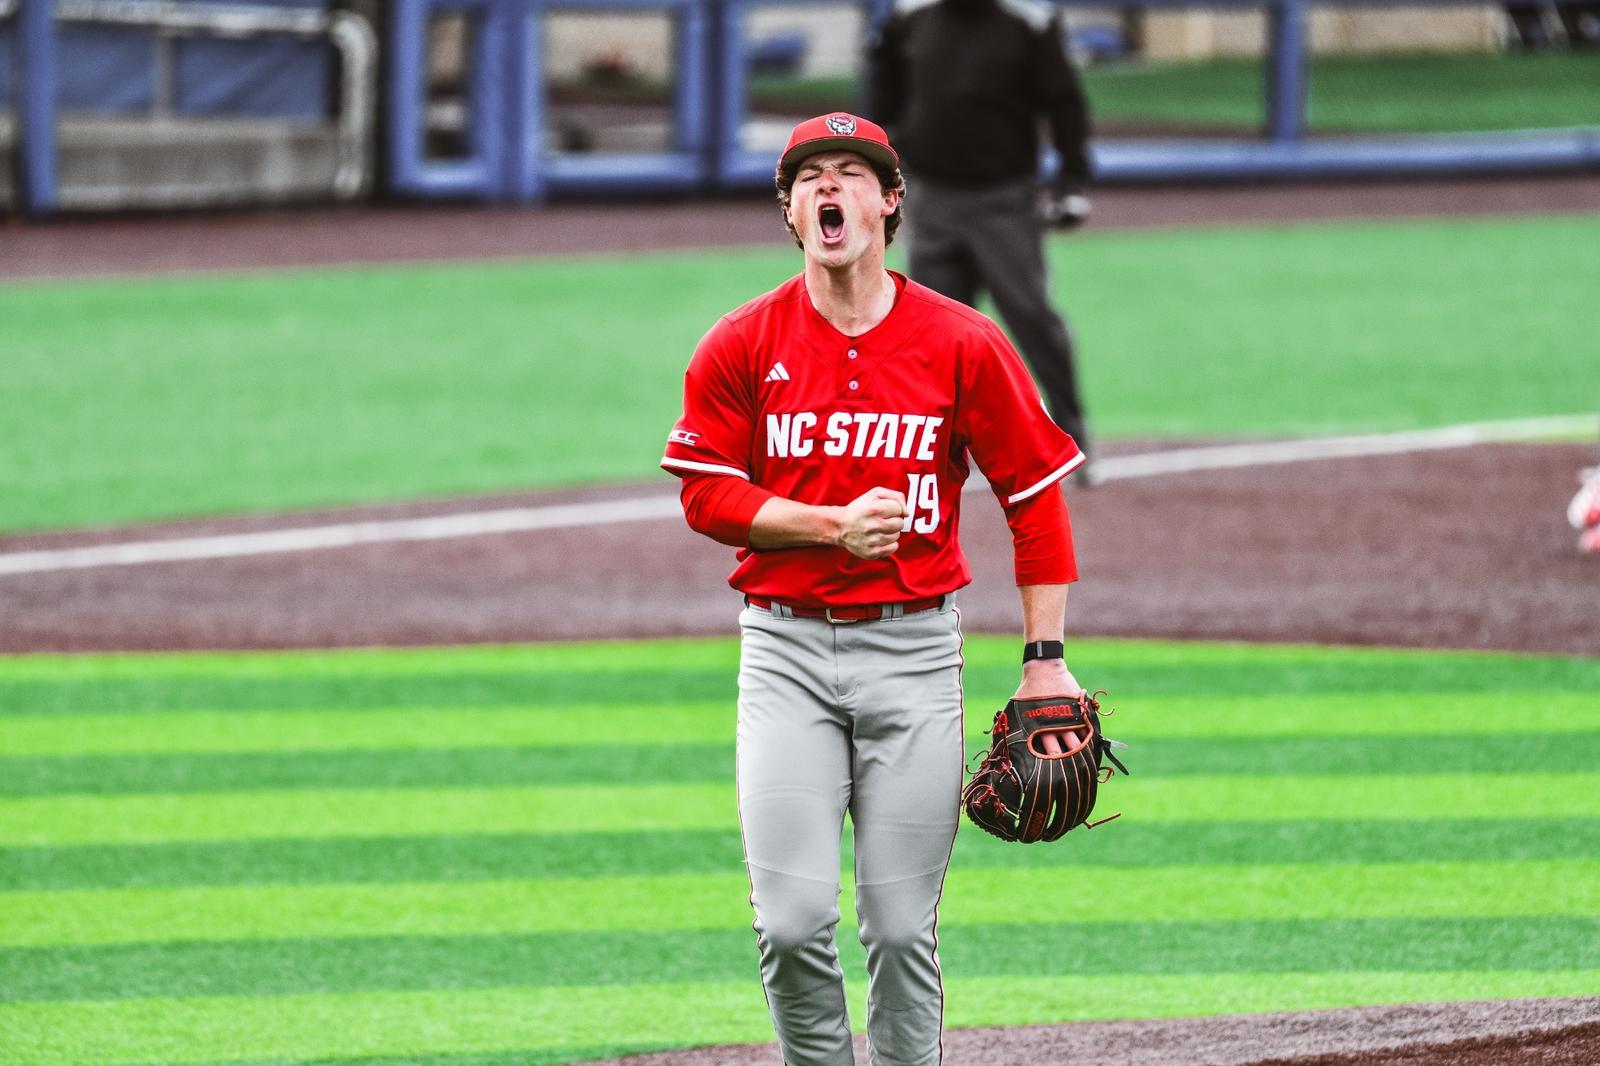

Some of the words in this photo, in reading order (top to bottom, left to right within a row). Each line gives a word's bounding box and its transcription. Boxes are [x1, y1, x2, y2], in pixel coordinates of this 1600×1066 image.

[767, 411, 817, 458] NC
[823, 411, 944, 461] STATE
[900, 473, 940, 534] 19
[1025, 705, 1073, 718] Wilson
